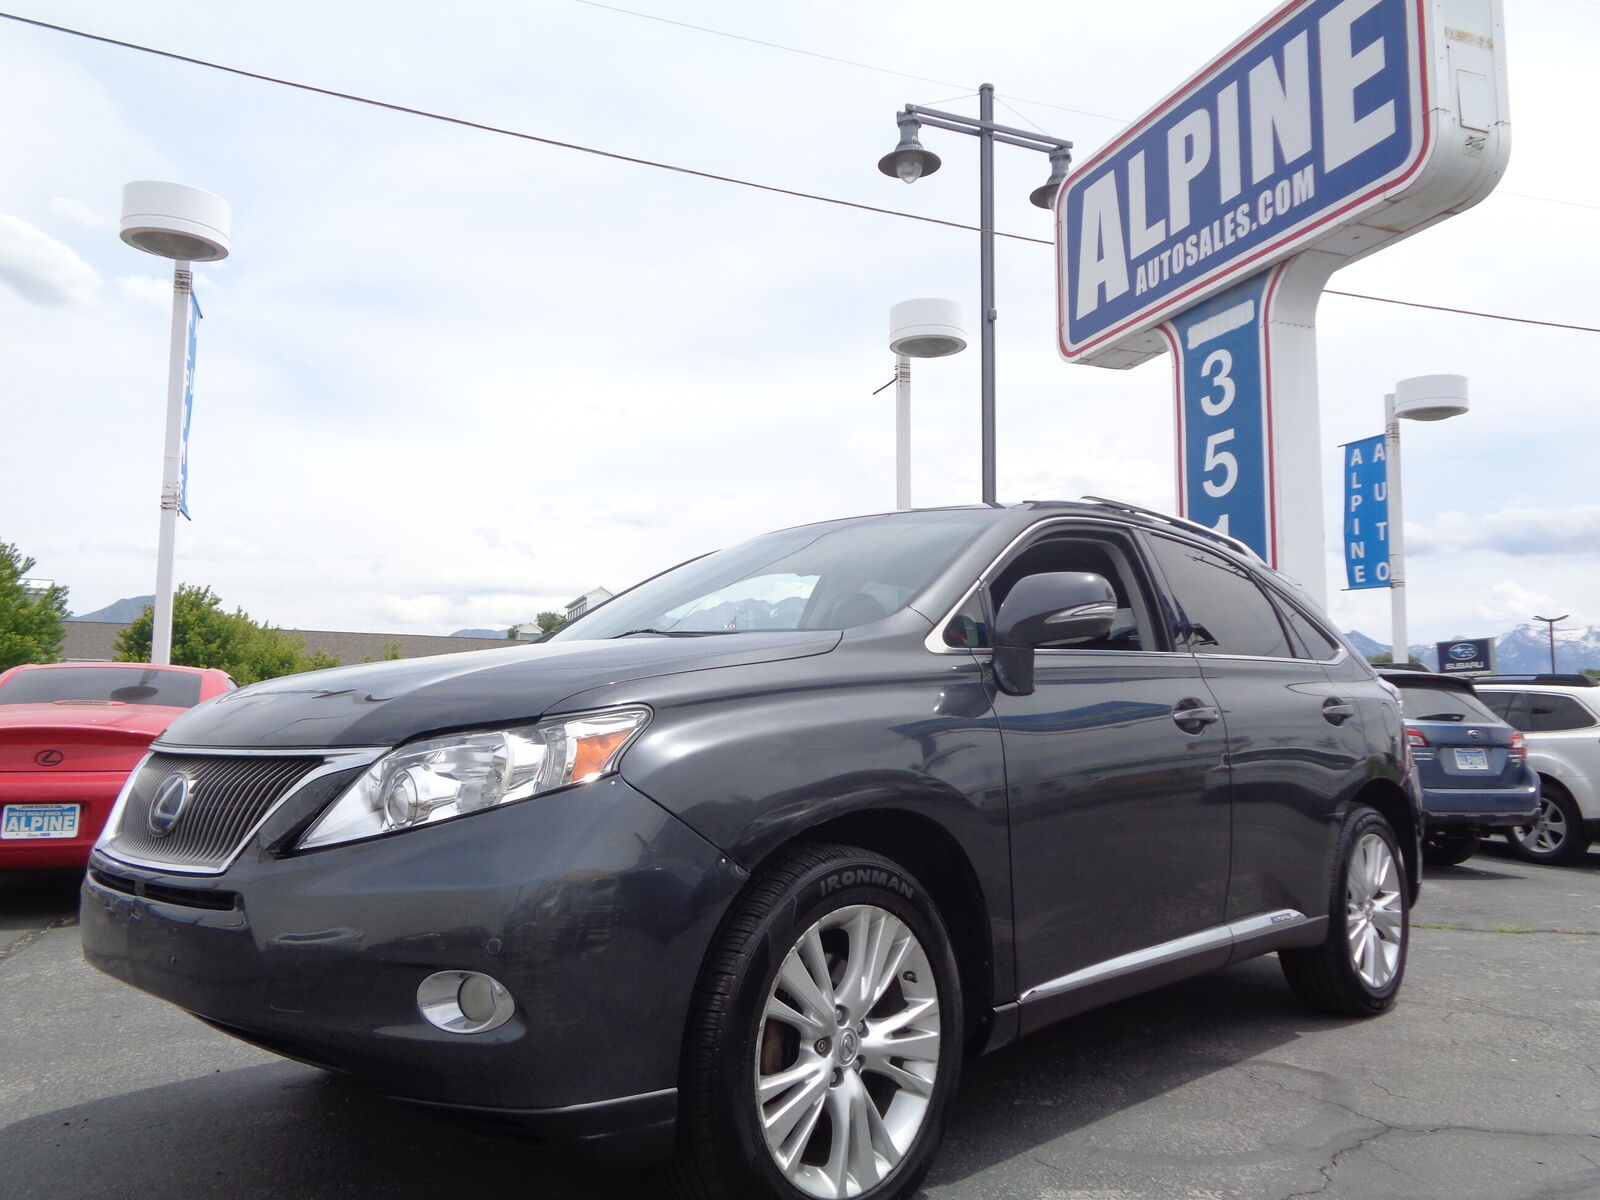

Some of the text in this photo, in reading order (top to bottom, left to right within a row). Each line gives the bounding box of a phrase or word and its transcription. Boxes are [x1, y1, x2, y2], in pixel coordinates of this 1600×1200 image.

[1076, 0, 1396, 320] ALPINE
[1135, 164, 1315, 296] AUTOSALES.COM
[1350, 448, 1366, 583] ALPINE
[1373, 443, 1390, 581] AUTO
[1445, 661, 1484, 670] SUBARU
[6, 816, 75, 832] ALPINE
[819, 869, 915, 899] IRONMAN
